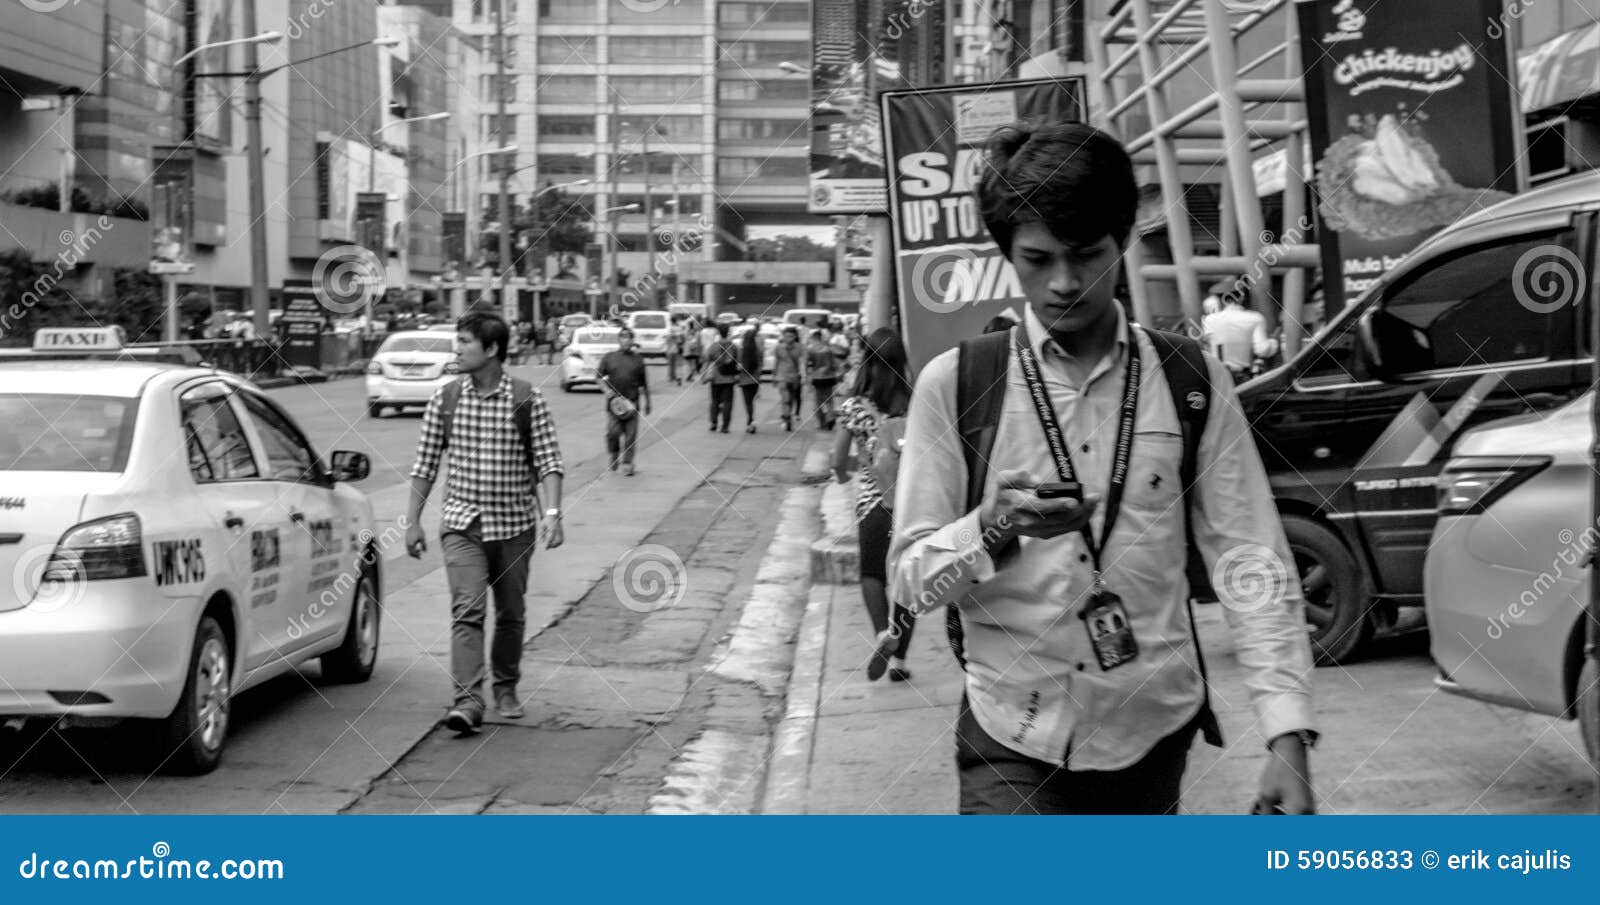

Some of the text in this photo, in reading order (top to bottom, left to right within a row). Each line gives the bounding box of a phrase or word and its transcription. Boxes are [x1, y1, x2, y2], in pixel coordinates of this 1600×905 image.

[1334, 44, 1475, 85] Chickenjoy
[898, 147, 992, 197] SA
[902, 195, 979, 242] UP TO
[1343, 256, 1381, 275] Mula
